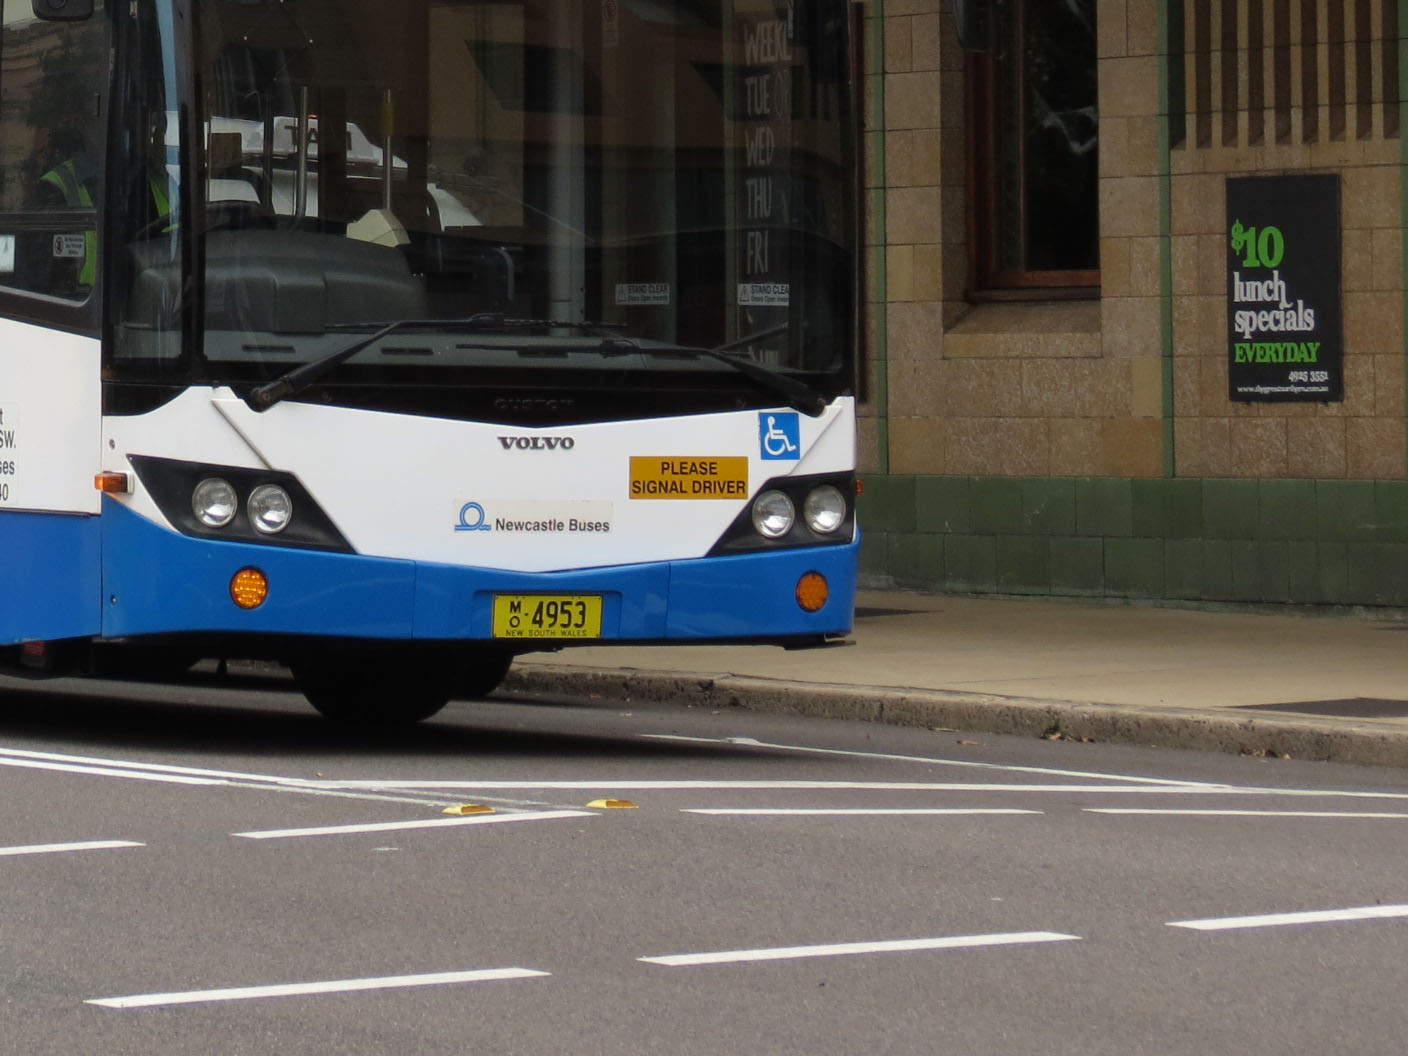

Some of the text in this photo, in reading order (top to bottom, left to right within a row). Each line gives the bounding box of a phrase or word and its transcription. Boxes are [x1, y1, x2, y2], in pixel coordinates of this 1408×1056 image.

[745, 21, 791, 64] WEEKL
[745, 74, 771, 116] TUE
[745, 127, 774, 167] WED
[745, 177, 773, 219] THU
[747, 230, 769, 276] FRI
[1231, 219, 1285, 268] $10
[751, 285, 789, 295] STAND CLEA
[1233, 270, 1293, 310] lunch
[1234, 299, 1315, 339] specials
[1234, 342, 1320, 363] EVERYDAY
[497, 436, 575, 450] VOLVO
[632, 480, 746, 495] SIGNAL DRIVER
[660, 461, 718, 476] PLEASE
[495, 518, 610, 532] Newcastle Buses
[506, 629, 587, 637] NEW SOUTH WALES
